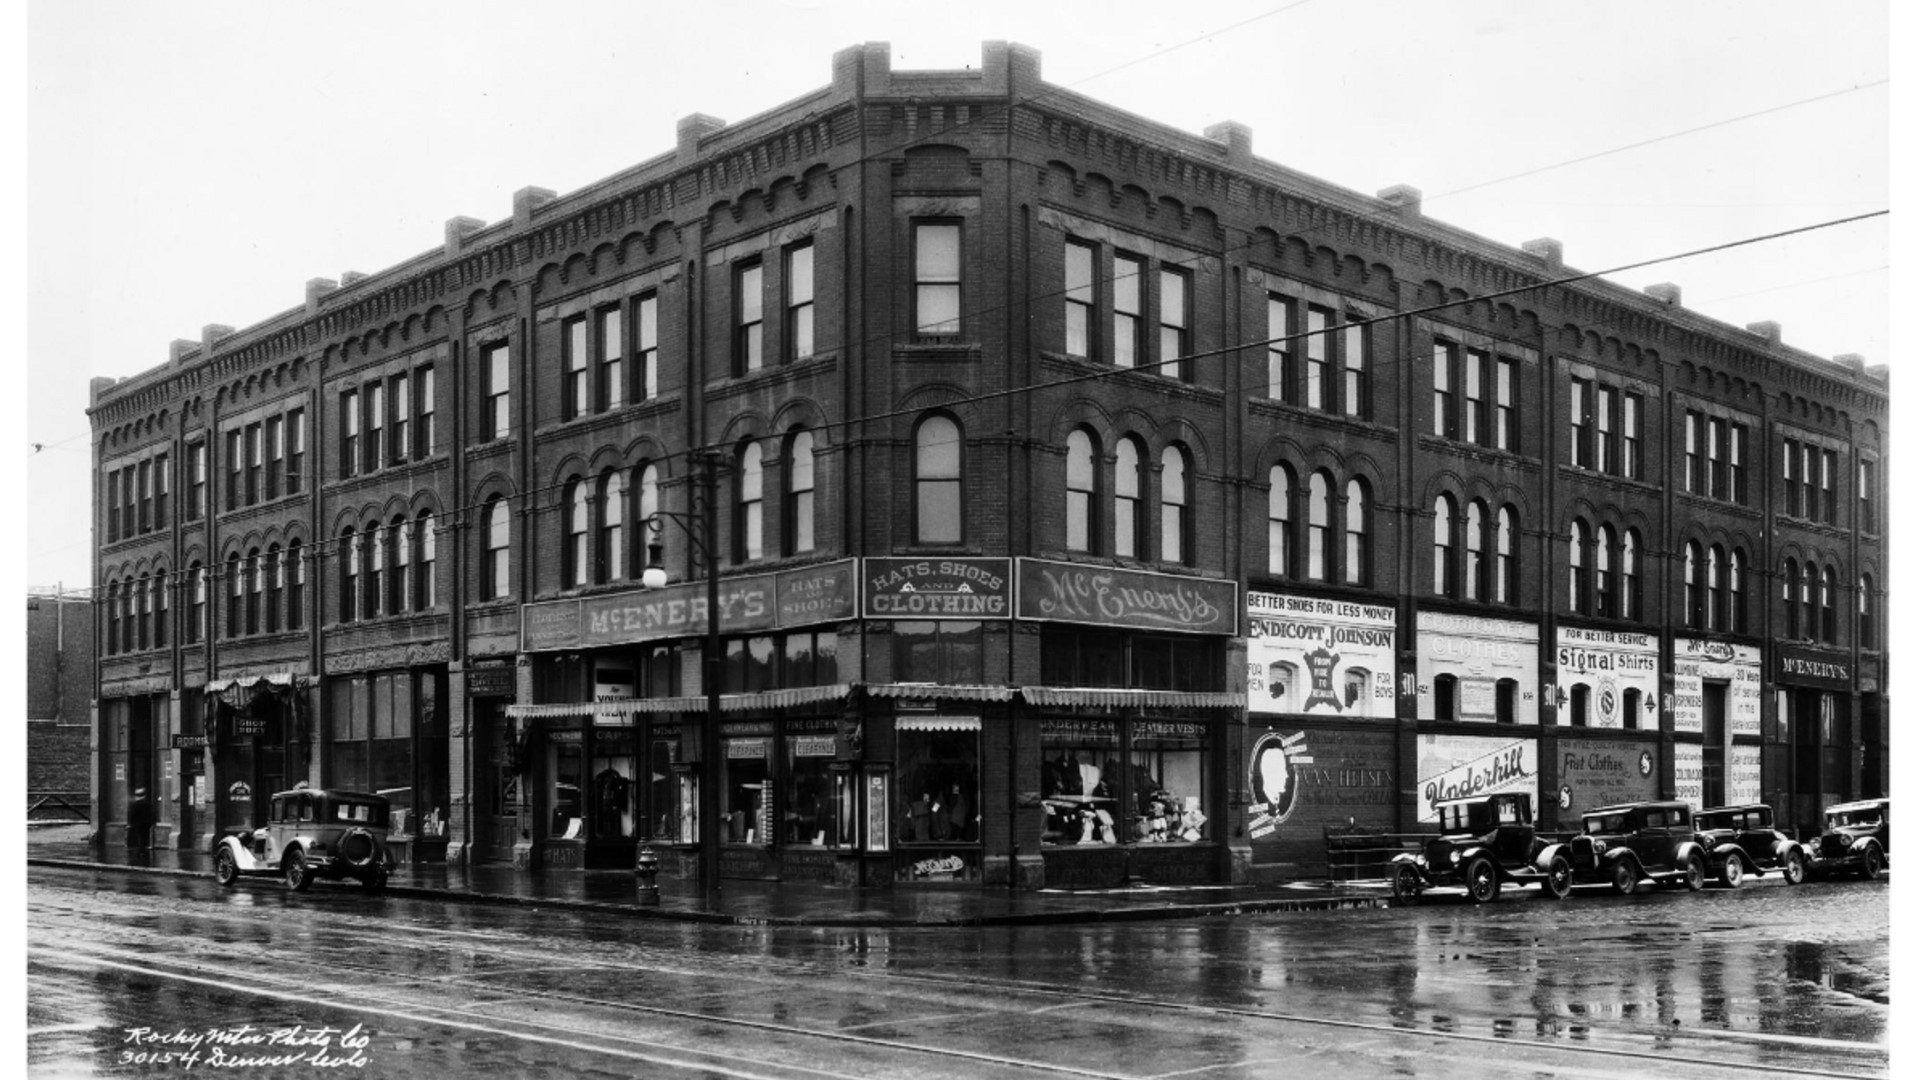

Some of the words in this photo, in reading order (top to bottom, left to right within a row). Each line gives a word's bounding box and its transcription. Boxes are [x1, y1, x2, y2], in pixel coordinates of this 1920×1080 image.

[792, 577, 836, 592] HATS
[940, 562, 1004, 590] SHOES
[873, 594, 1006, 613] CLOTHING
[1248, 593, 1285, 609] BETTER
[1286, 598, 1314, 613] SHOES
[1317, 602, 1334, 614] FOR
[1337, 604, 1360, 617] LESS
[1363, 607, 1393, 621] MONEY
[1247, 618, 1326, 641] ENDICOTT
[1325, 626, 1393, 649] JOHNSON
[1566, 629, 1582, 639] FOR
[1585, 632, 1615, 643] BETTER
[1618, 634, 1648, 646] SERVICE
[1432, 637, 1520, 663] CLOTHES
[1559, 647, 1614, 672] Signal
[1618, 654, 1654, 670] Shirts
[1377, 673, 1391, 684] FOR
[1375, 686, 1394, 698] BOYS
[1040, 720, 1115, 731] UNDERWEAR
[1132, 721, 1176, 734] LEATHER
[1177, 723, 1207, 735] VESTS
[1587, 753, 1624, 772] Clothes
[1425, 745, 1530, 812] Underhill
